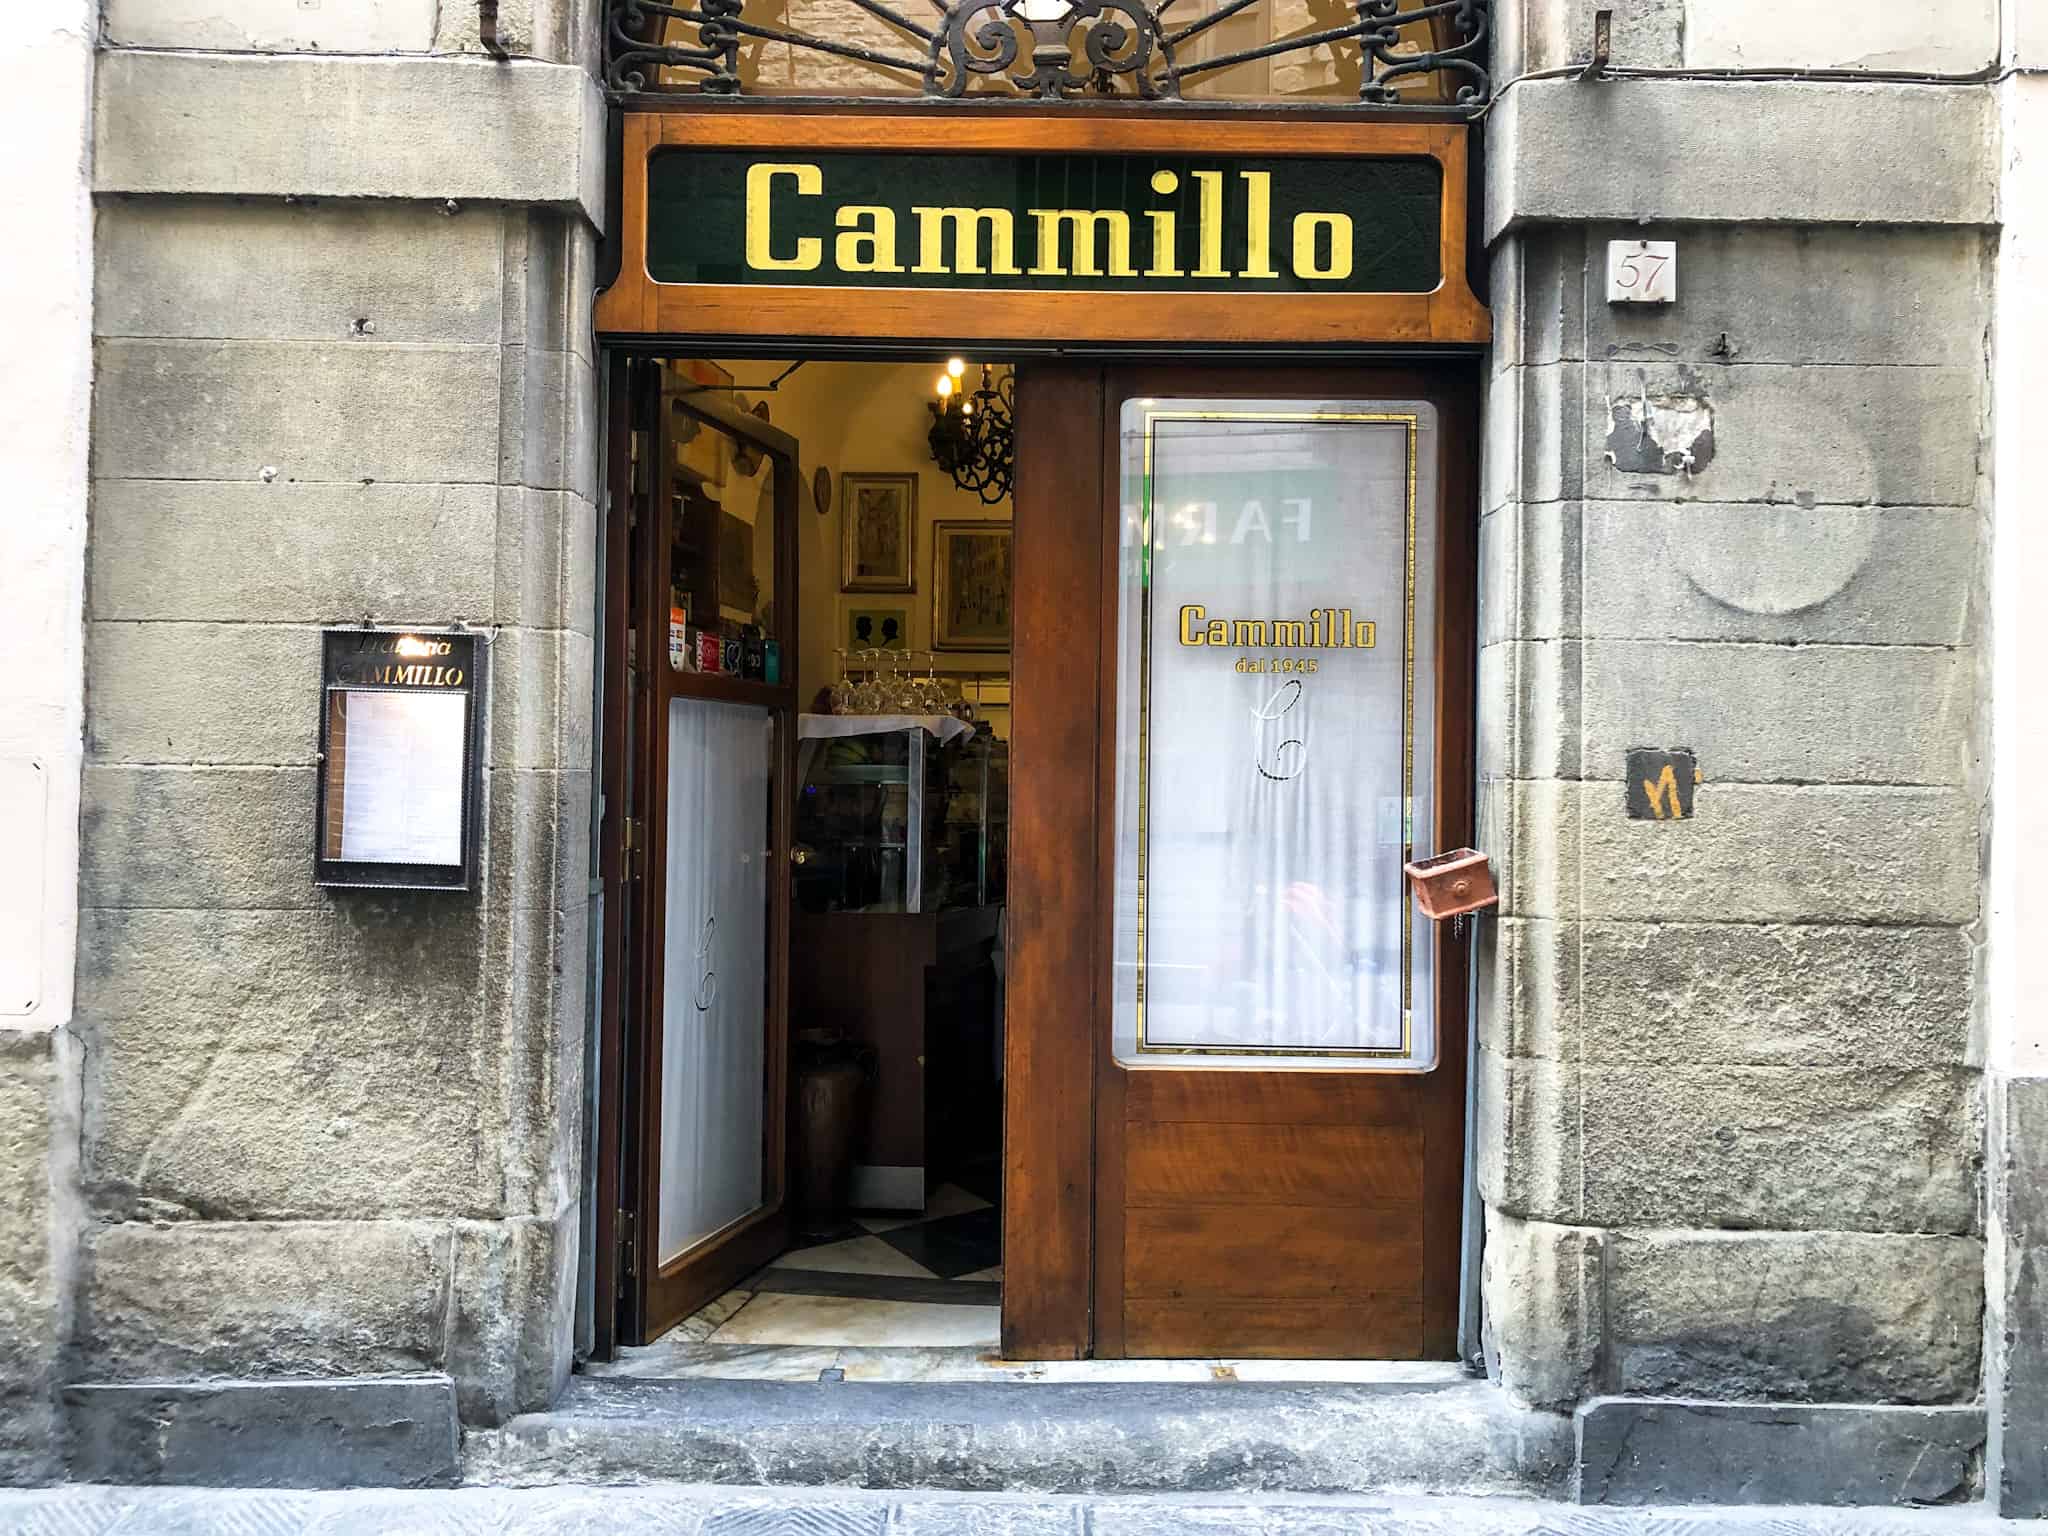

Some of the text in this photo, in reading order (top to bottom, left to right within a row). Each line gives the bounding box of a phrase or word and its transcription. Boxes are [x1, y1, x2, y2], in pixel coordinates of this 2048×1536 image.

[746, 163, 1353, 279] Cammillo
[1616, 254, 1669, 292] 57
[1178, 604, 1377, 649] Cammillo
[1235, 657, 1319, 674] dal 1945
